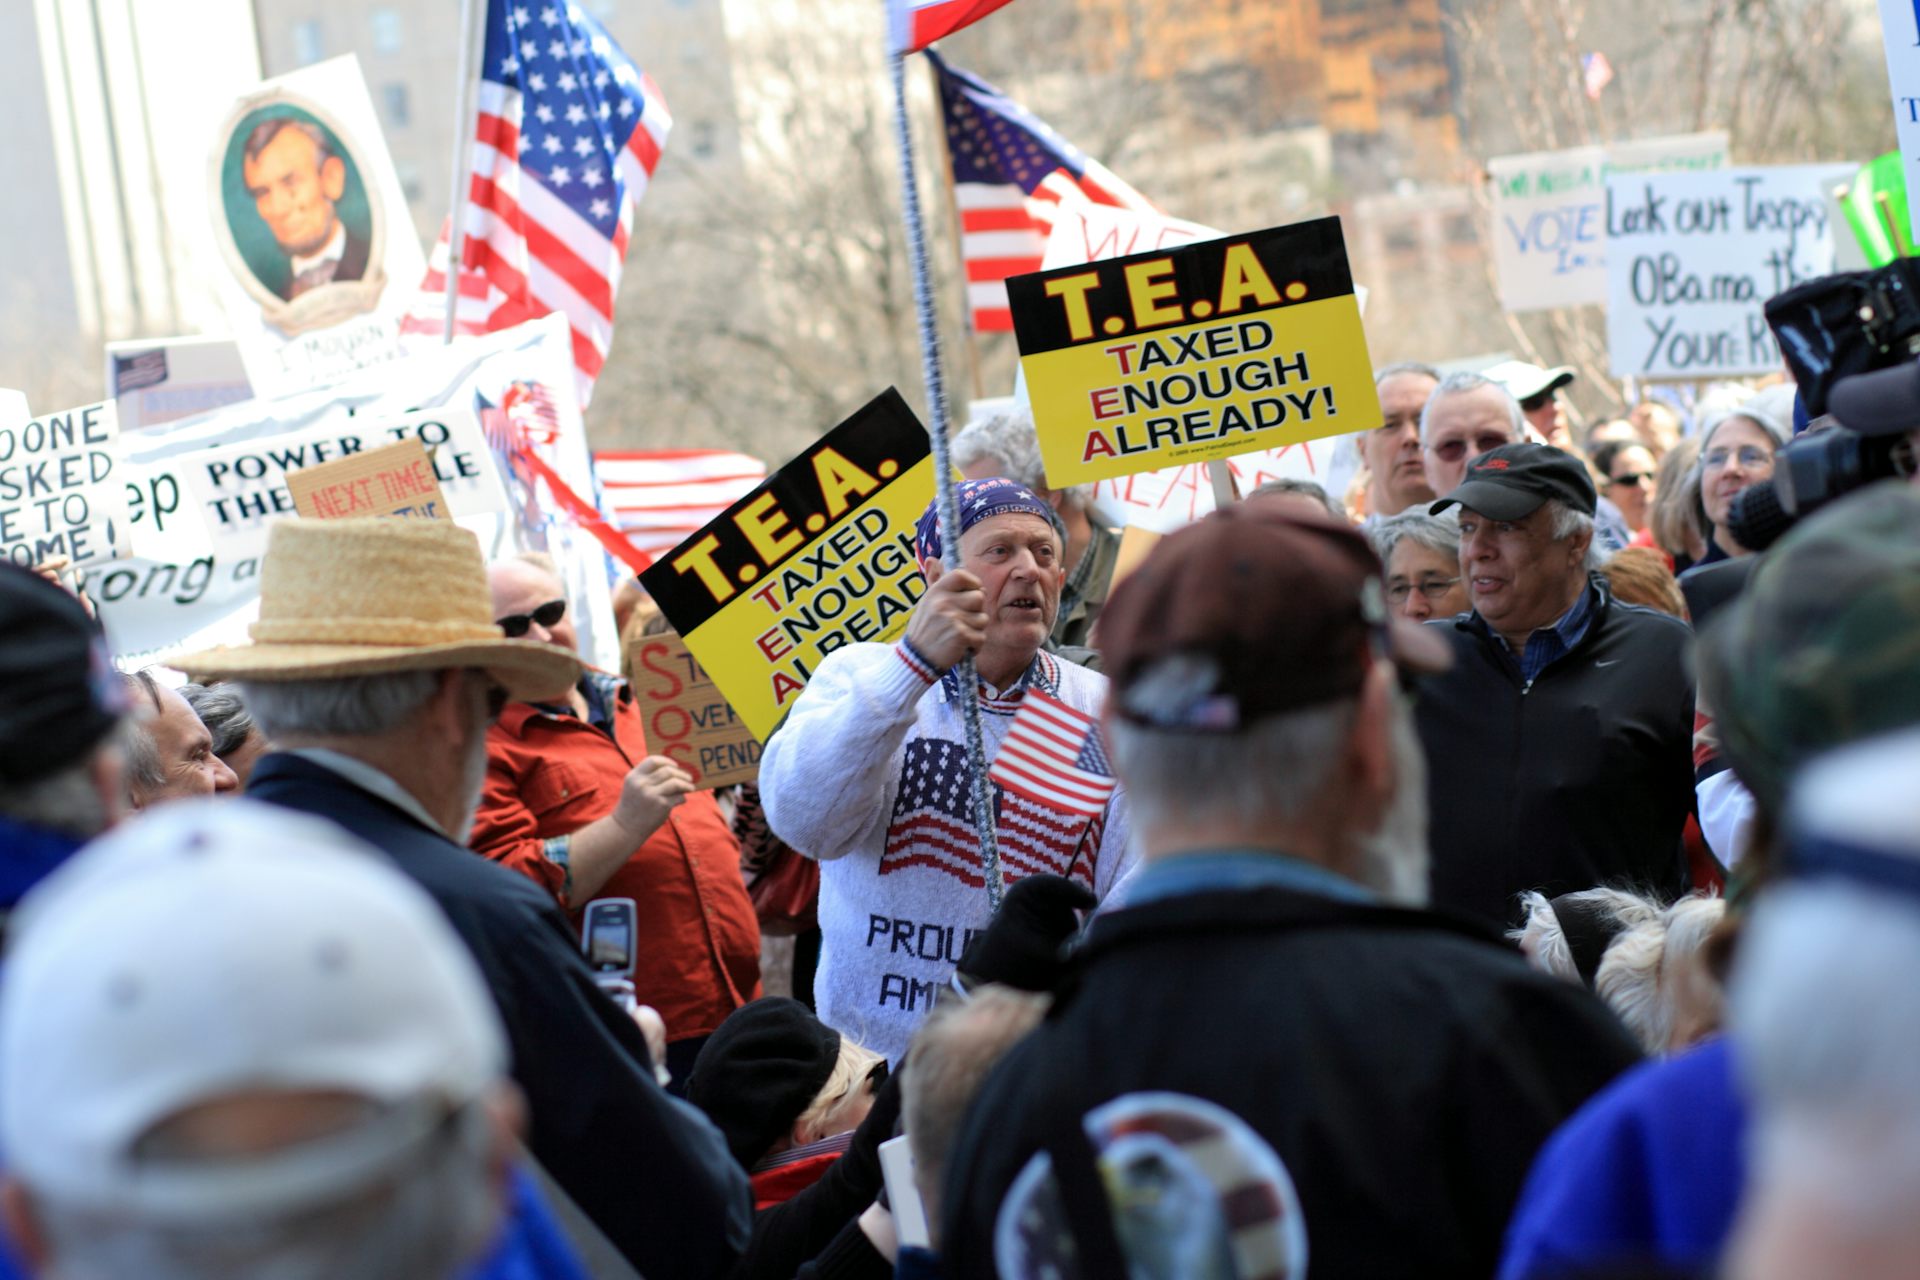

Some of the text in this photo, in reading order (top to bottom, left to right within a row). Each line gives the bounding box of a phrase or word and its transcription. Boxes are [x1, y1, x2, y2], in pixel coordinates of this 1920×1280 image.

[1503, 204, 1600, 253] VOTE
[1675, 197, 1731, 234] out
[1044, 242, 1308, 341] T.E.A.
[1106, 320, 1273, 375] TAXED
[1090, 352, 1309, 420] ENOUGH
[1082, 386, 1337, 462] ALREADY!
[33, 494, 89, 533] TO
[208, 486, 294, 524] THE
[311, 478, 375, 519] NEXT
[671, 445, 899, 605] T.E.A.
[751, 508, 889, 613] TAXED
[866, 913, 988, 964] PROU
[878, 973, 949, 1014] AM
